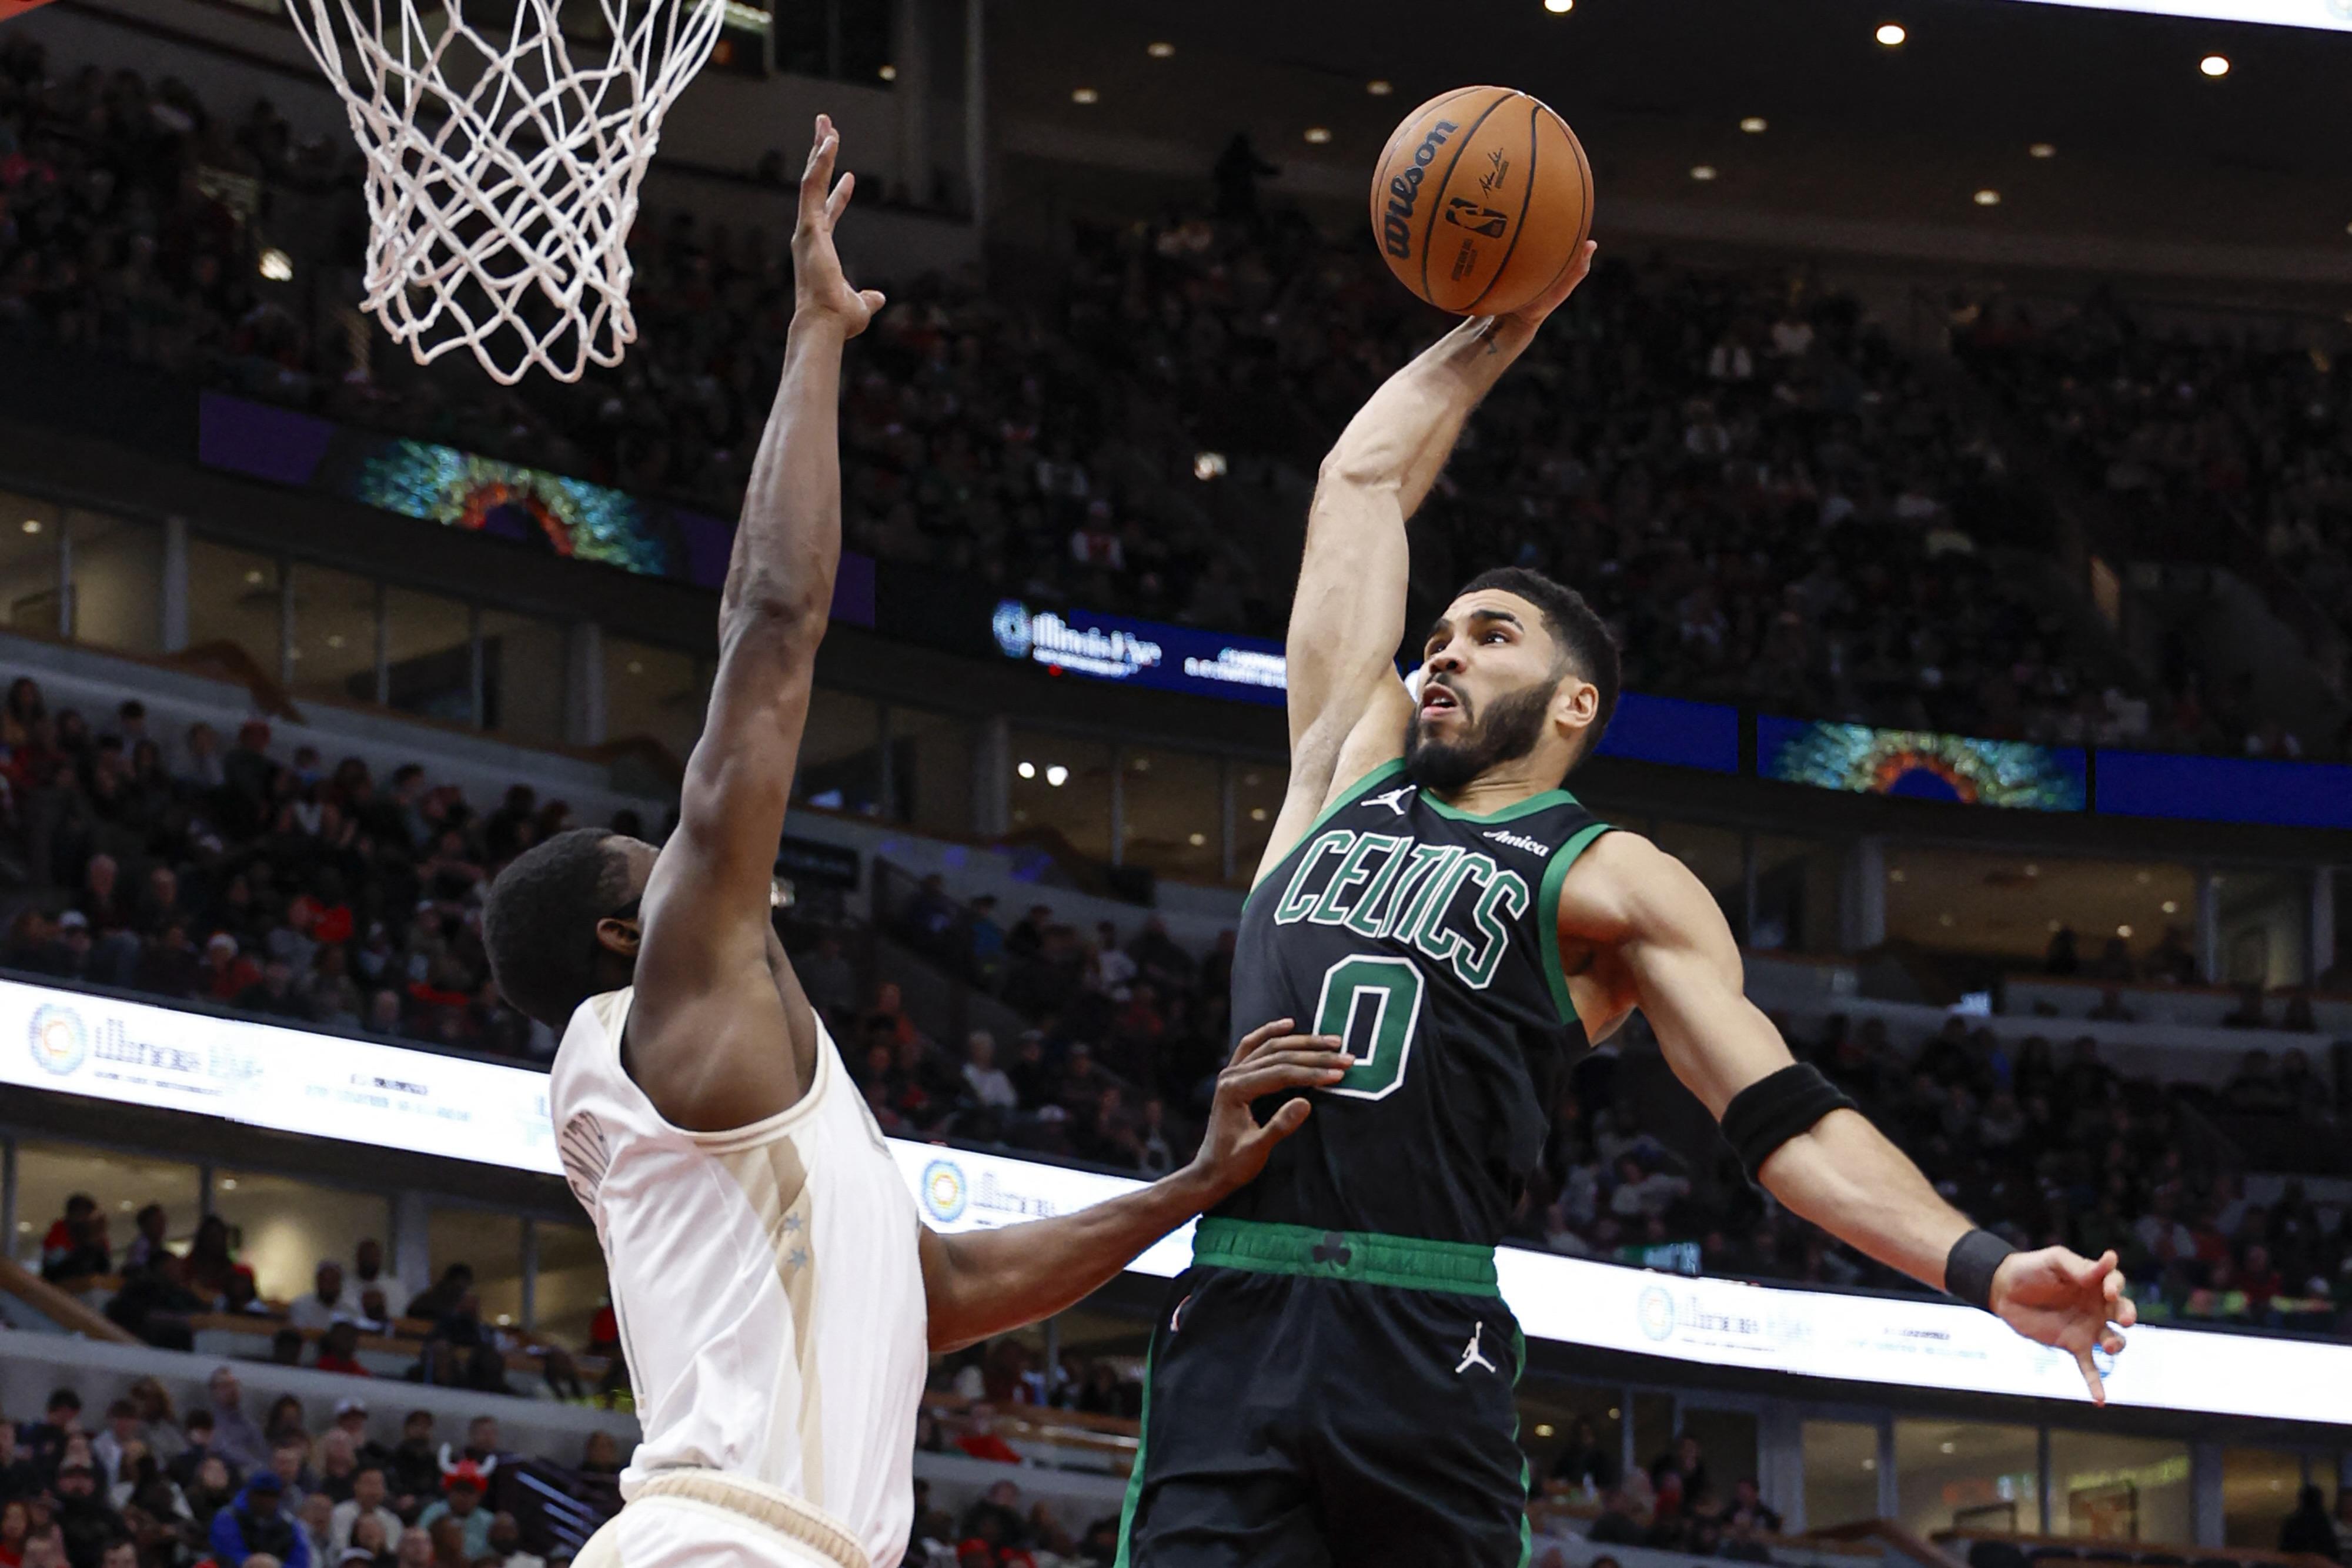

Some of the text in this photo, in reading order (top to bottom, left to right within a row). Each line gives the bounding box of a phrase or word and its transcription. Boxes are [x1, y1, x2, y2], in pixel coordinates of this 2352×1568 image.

[1274, 829, 1530, 990] CELTICS
[1482, 830, 1549, 857] Amica
[1312, 954, 1425, 1101] 0
